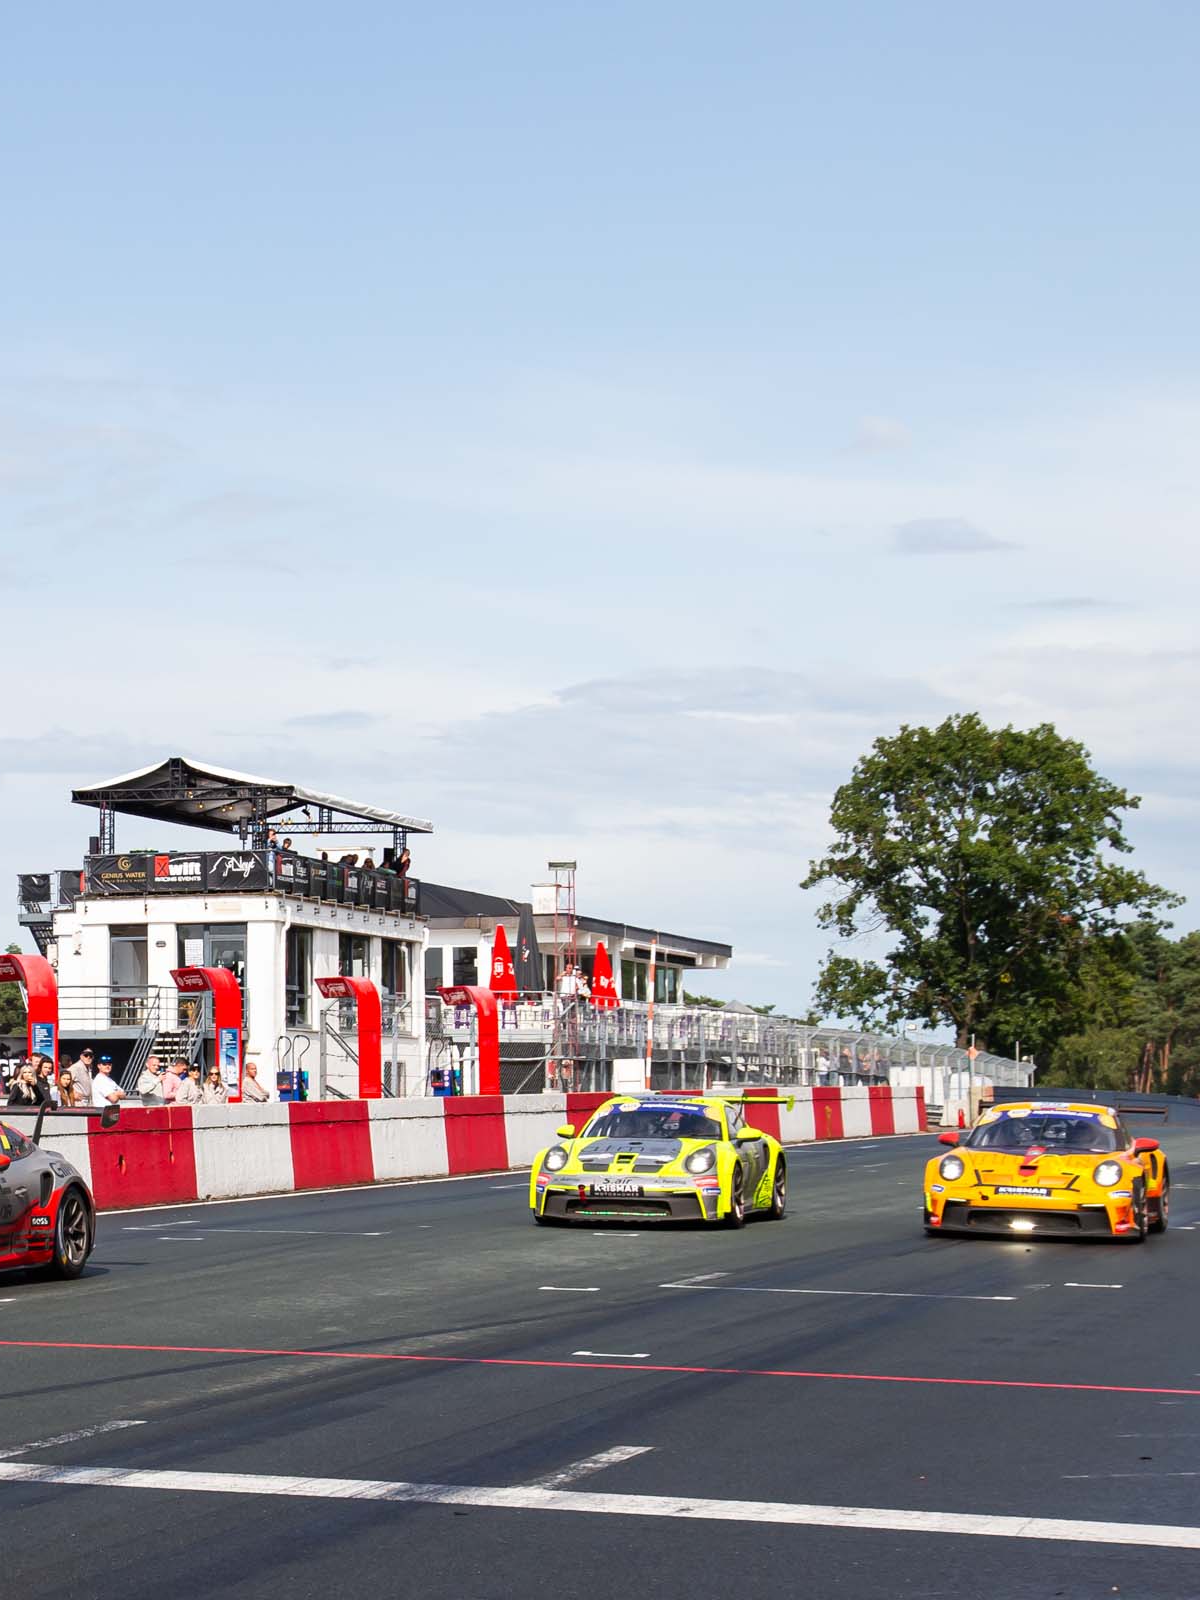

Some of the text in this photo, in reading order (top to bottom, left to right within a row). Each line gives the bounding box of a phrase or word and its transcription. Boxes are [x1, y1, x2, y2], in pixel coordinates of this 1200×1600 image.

[101, 871, 147, 880] GENIUS WATER
[594, 1183, 639, 1192] KRISMAR
